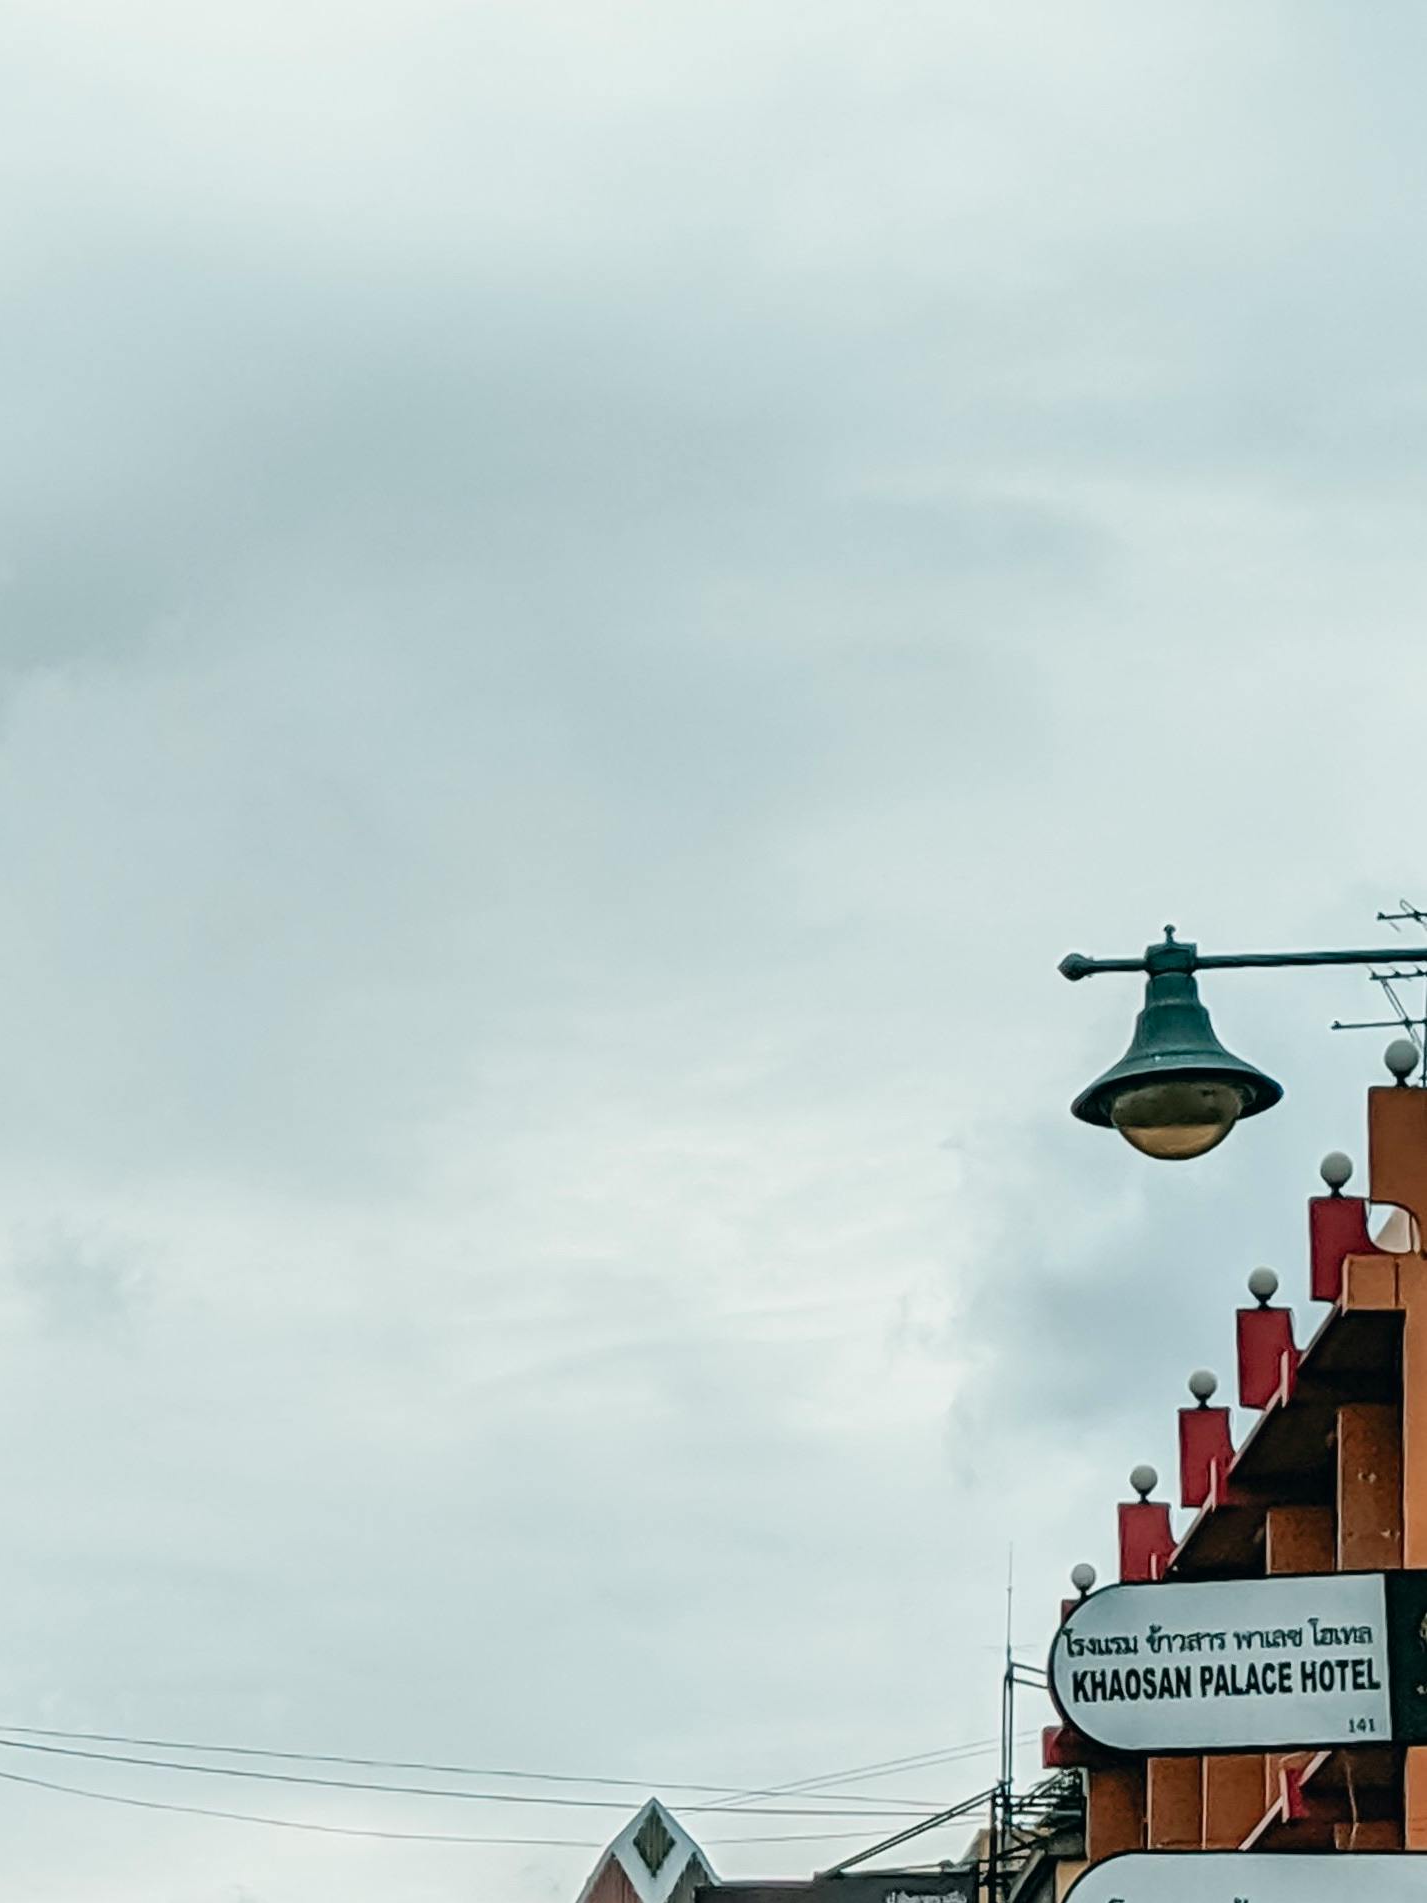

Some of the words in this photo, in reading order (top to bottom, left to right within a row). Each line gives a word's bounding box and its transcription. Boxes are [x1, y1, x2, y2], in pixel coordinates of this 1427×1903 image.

[1062, 1628, 1138, 1657] โรงแรม
[1146, 1623, 1227, 1654] ข้าวสาร
[1072, 1664, 1192, 1703] KHAOSAN
[1199, 1660, 1293, 1697] PALACE
[1300, 1656, 1381, 1693] HOTEL
[1348, 1717, 1376, 1734] 141
